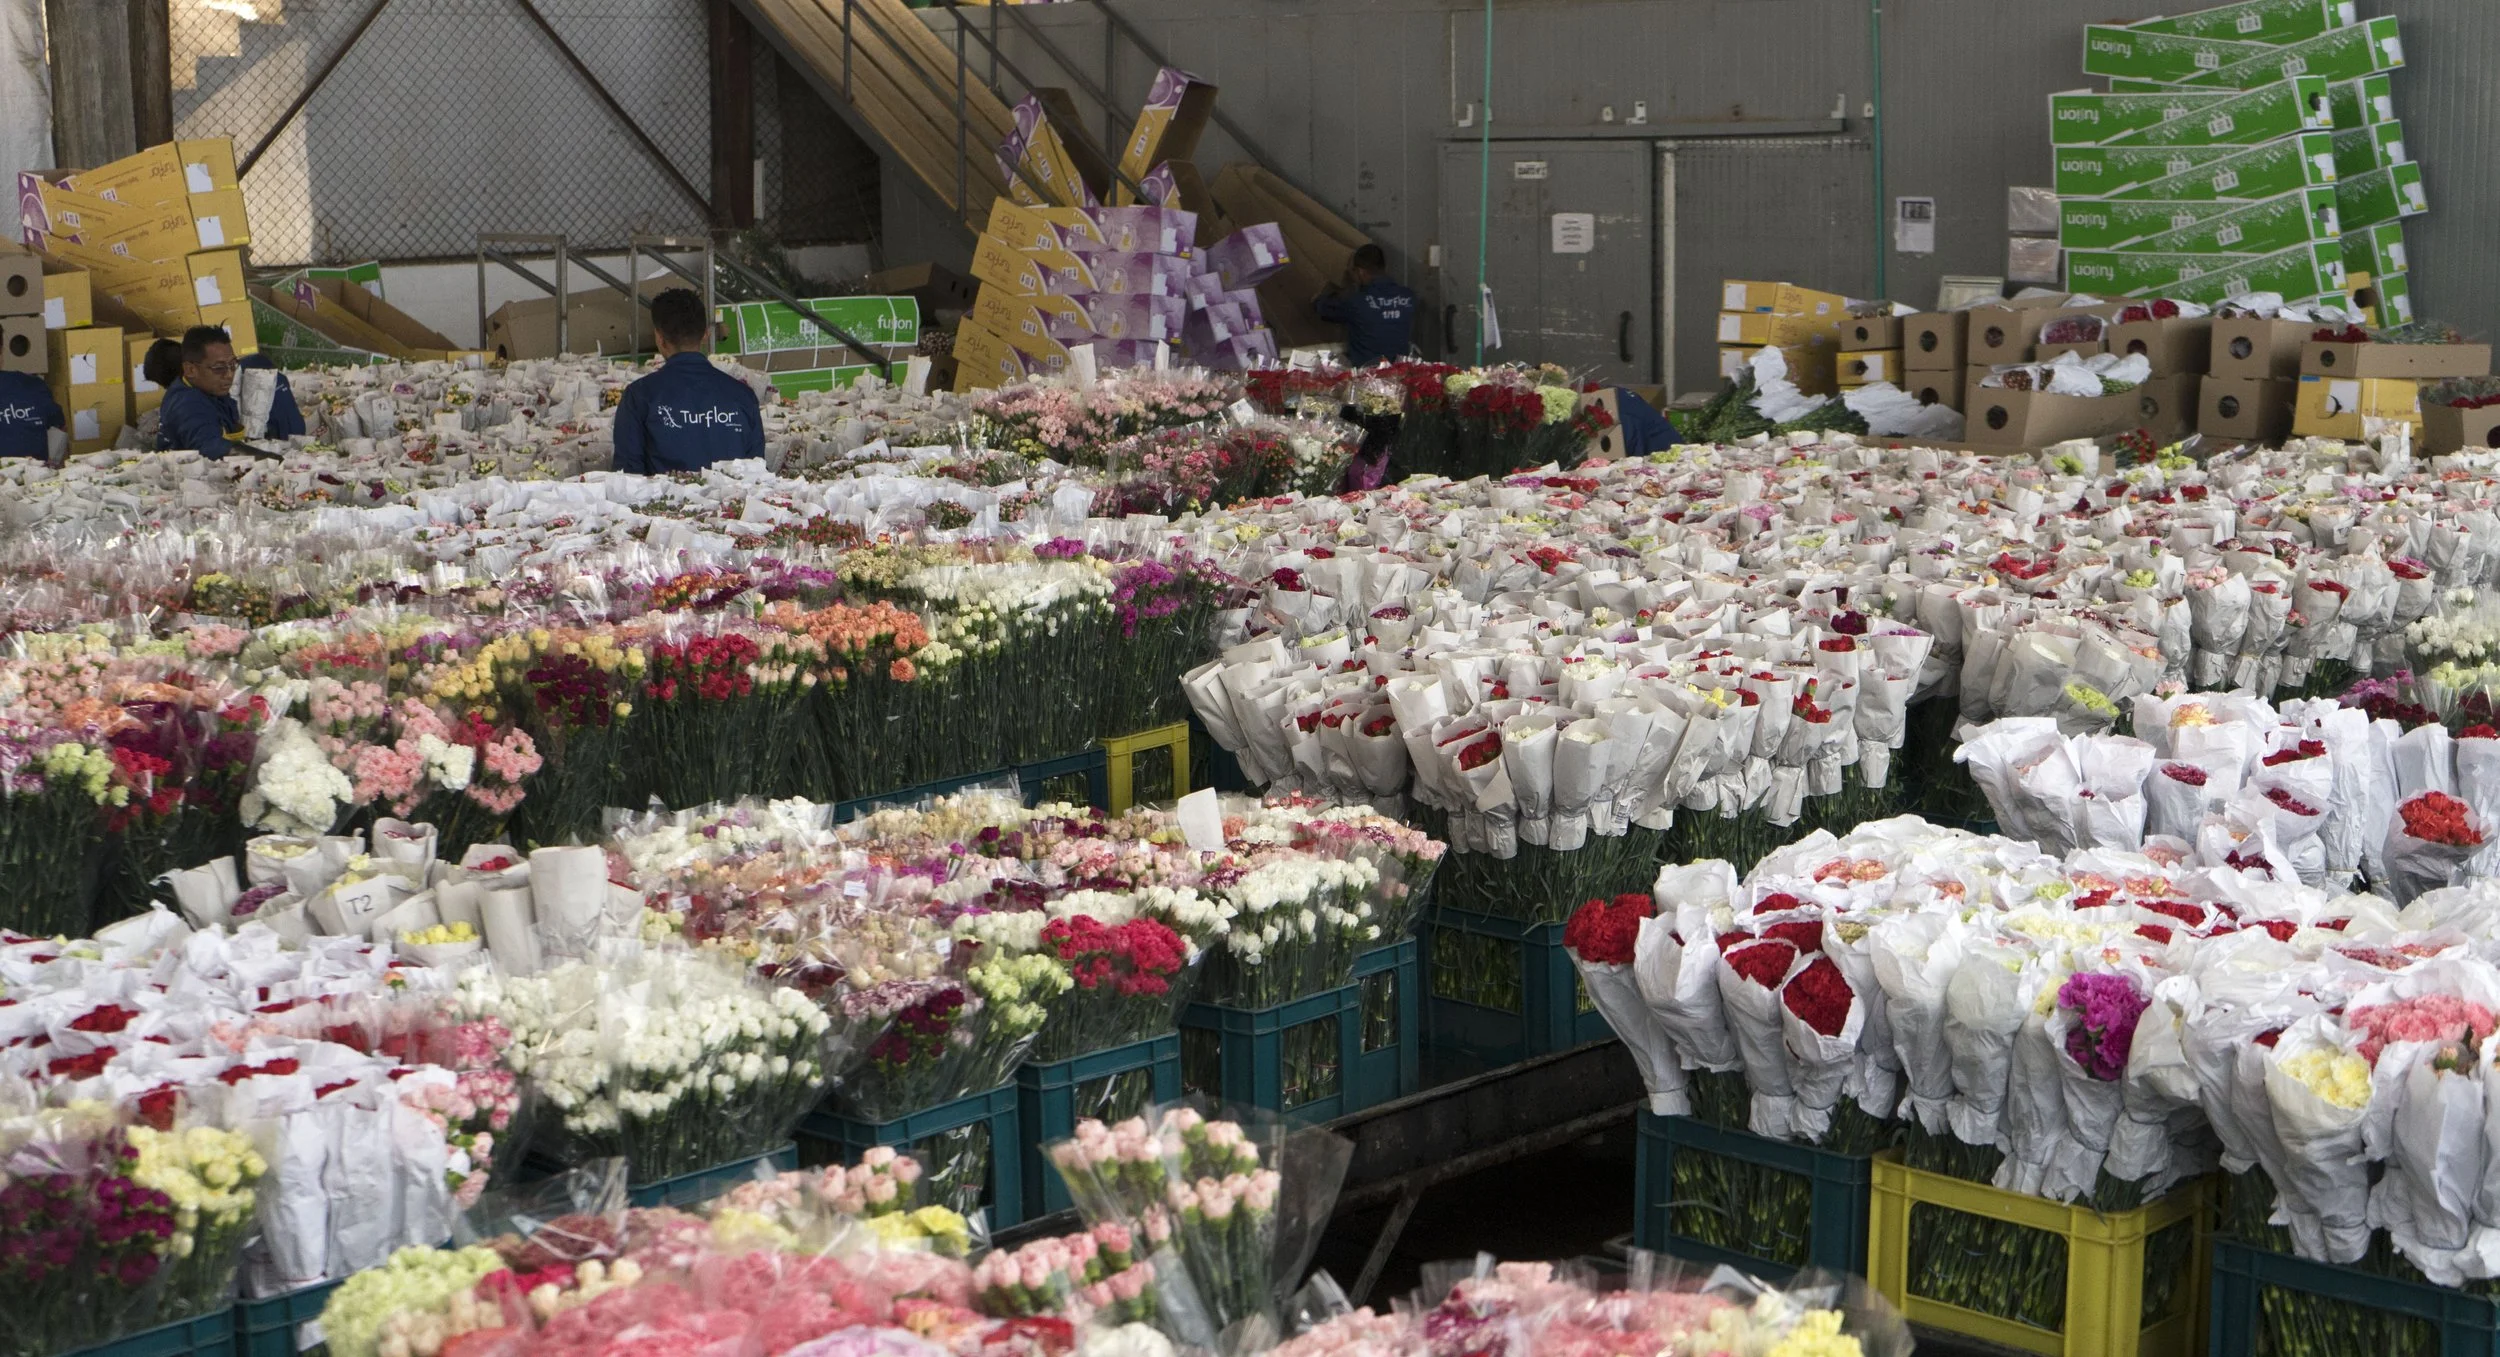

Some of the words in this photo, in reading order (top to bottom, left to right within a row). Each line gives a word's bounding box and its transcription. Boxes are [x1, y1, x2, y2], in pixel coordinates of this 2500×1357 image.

[1377, 296, 1411, 308] Turflor
[680, 406, 735, 428] Turflor
[345, 895, 374, 915] T2
